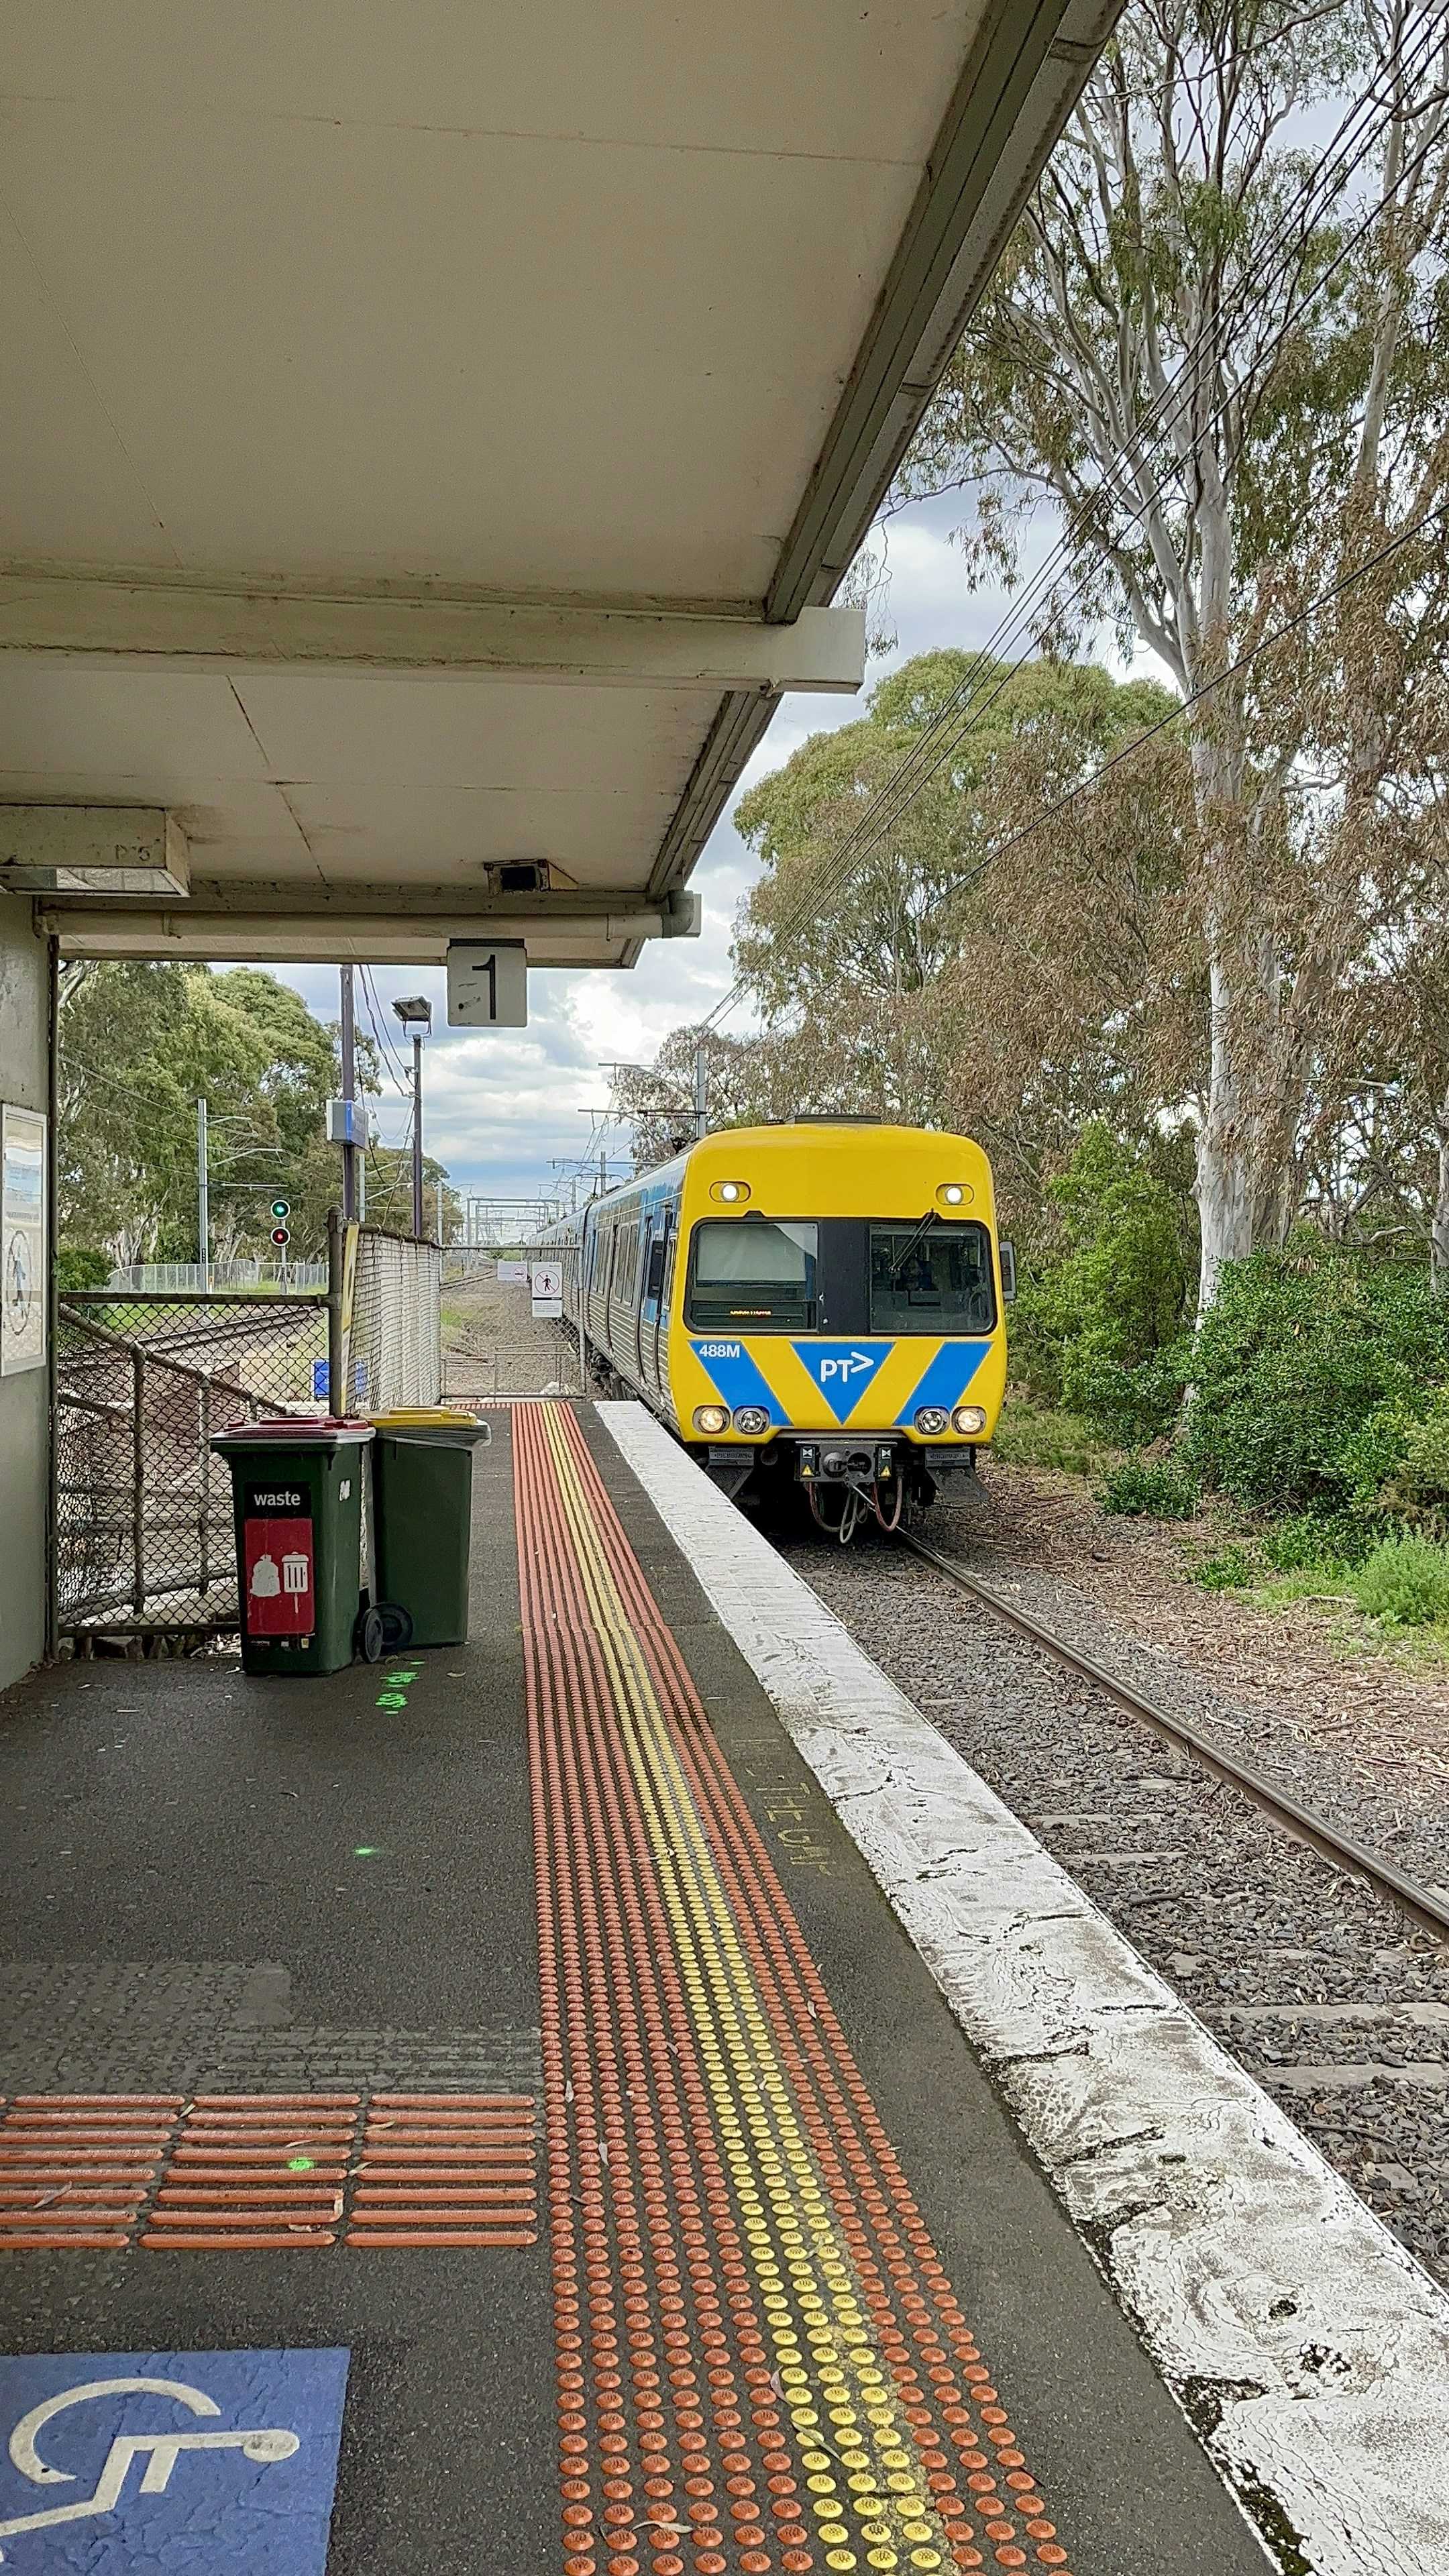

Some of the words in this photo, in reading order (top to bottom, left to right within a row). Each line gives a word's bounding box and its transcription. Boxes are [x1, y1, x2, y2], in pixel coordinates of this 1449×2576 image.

[472, 954, 496, 1020] 1
[698, 1344, 741, 1358] 488M
[254, 1491, 301, 1506] waste
